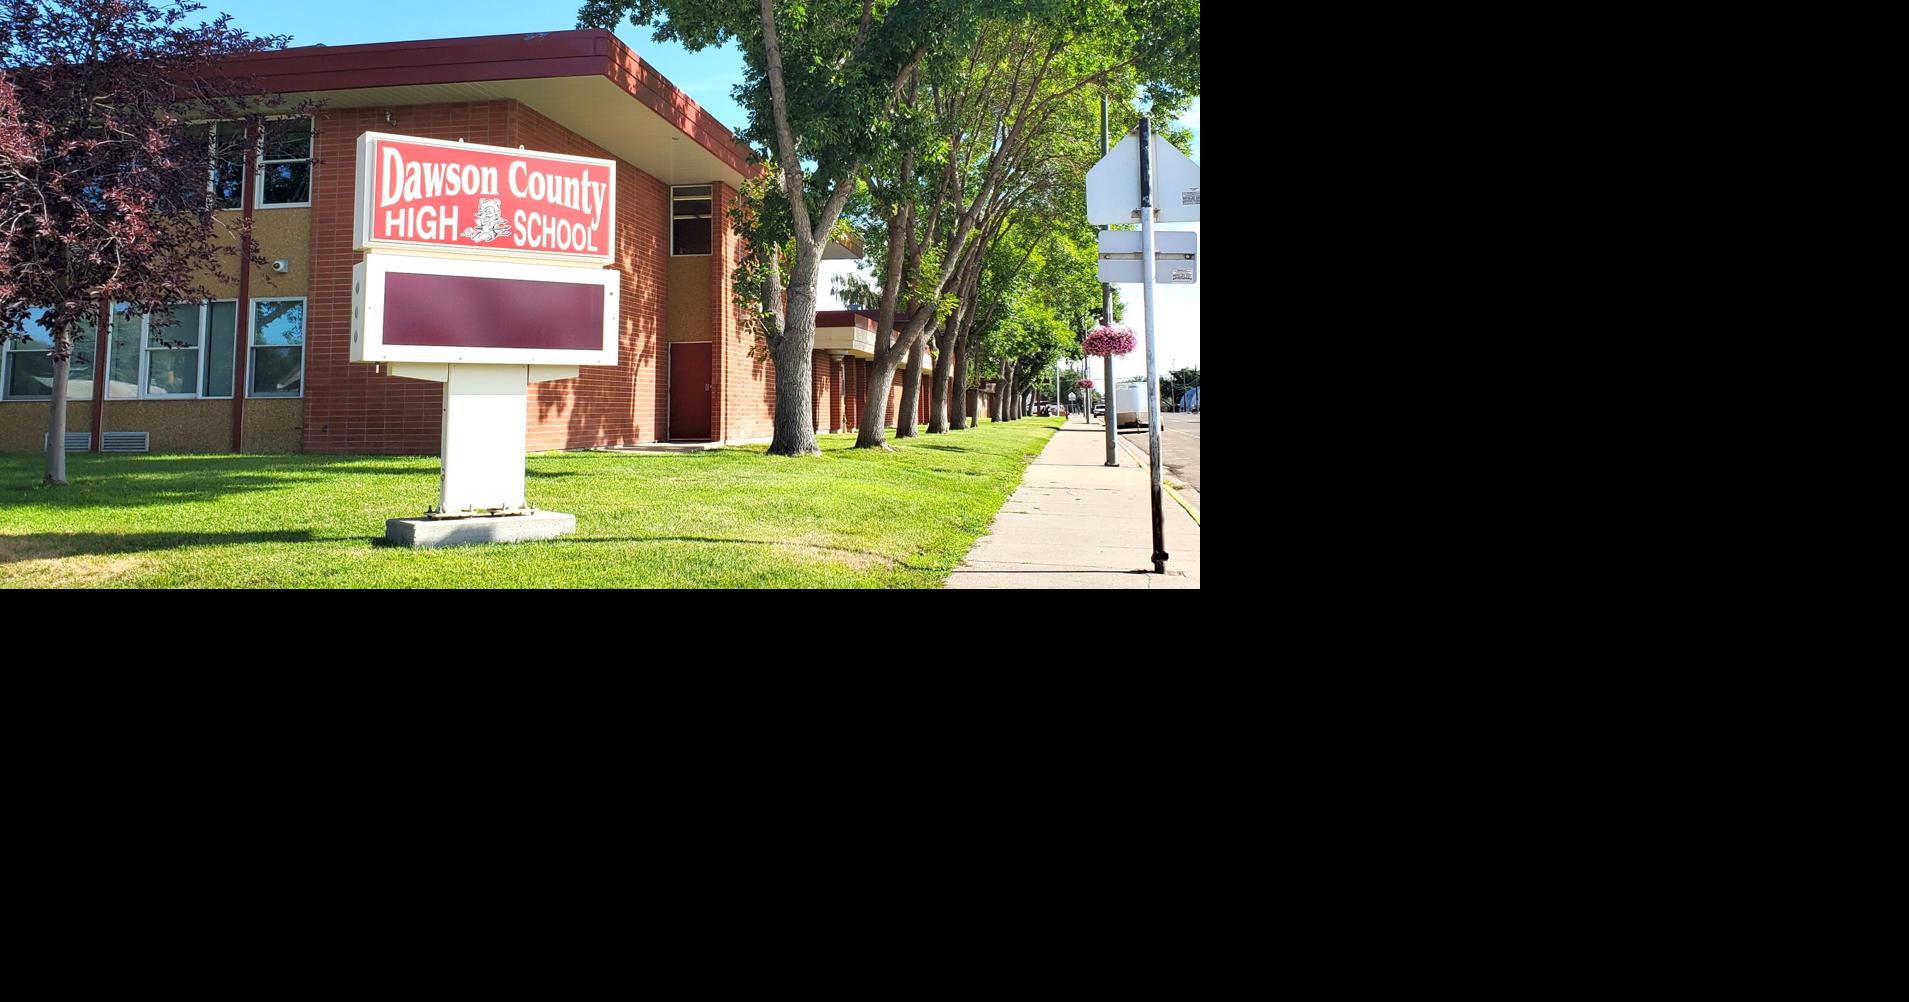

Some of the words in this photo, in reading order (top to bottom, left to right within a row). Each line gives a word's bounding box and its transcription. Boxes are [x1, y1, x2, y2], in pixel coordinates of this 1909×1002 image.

[380, 146, 499, 207] Dawson
[508, 160, 607, 231] County
[385, 205, 459, 241] HIGH
[513, 209, 599, 251] SCHOOL
